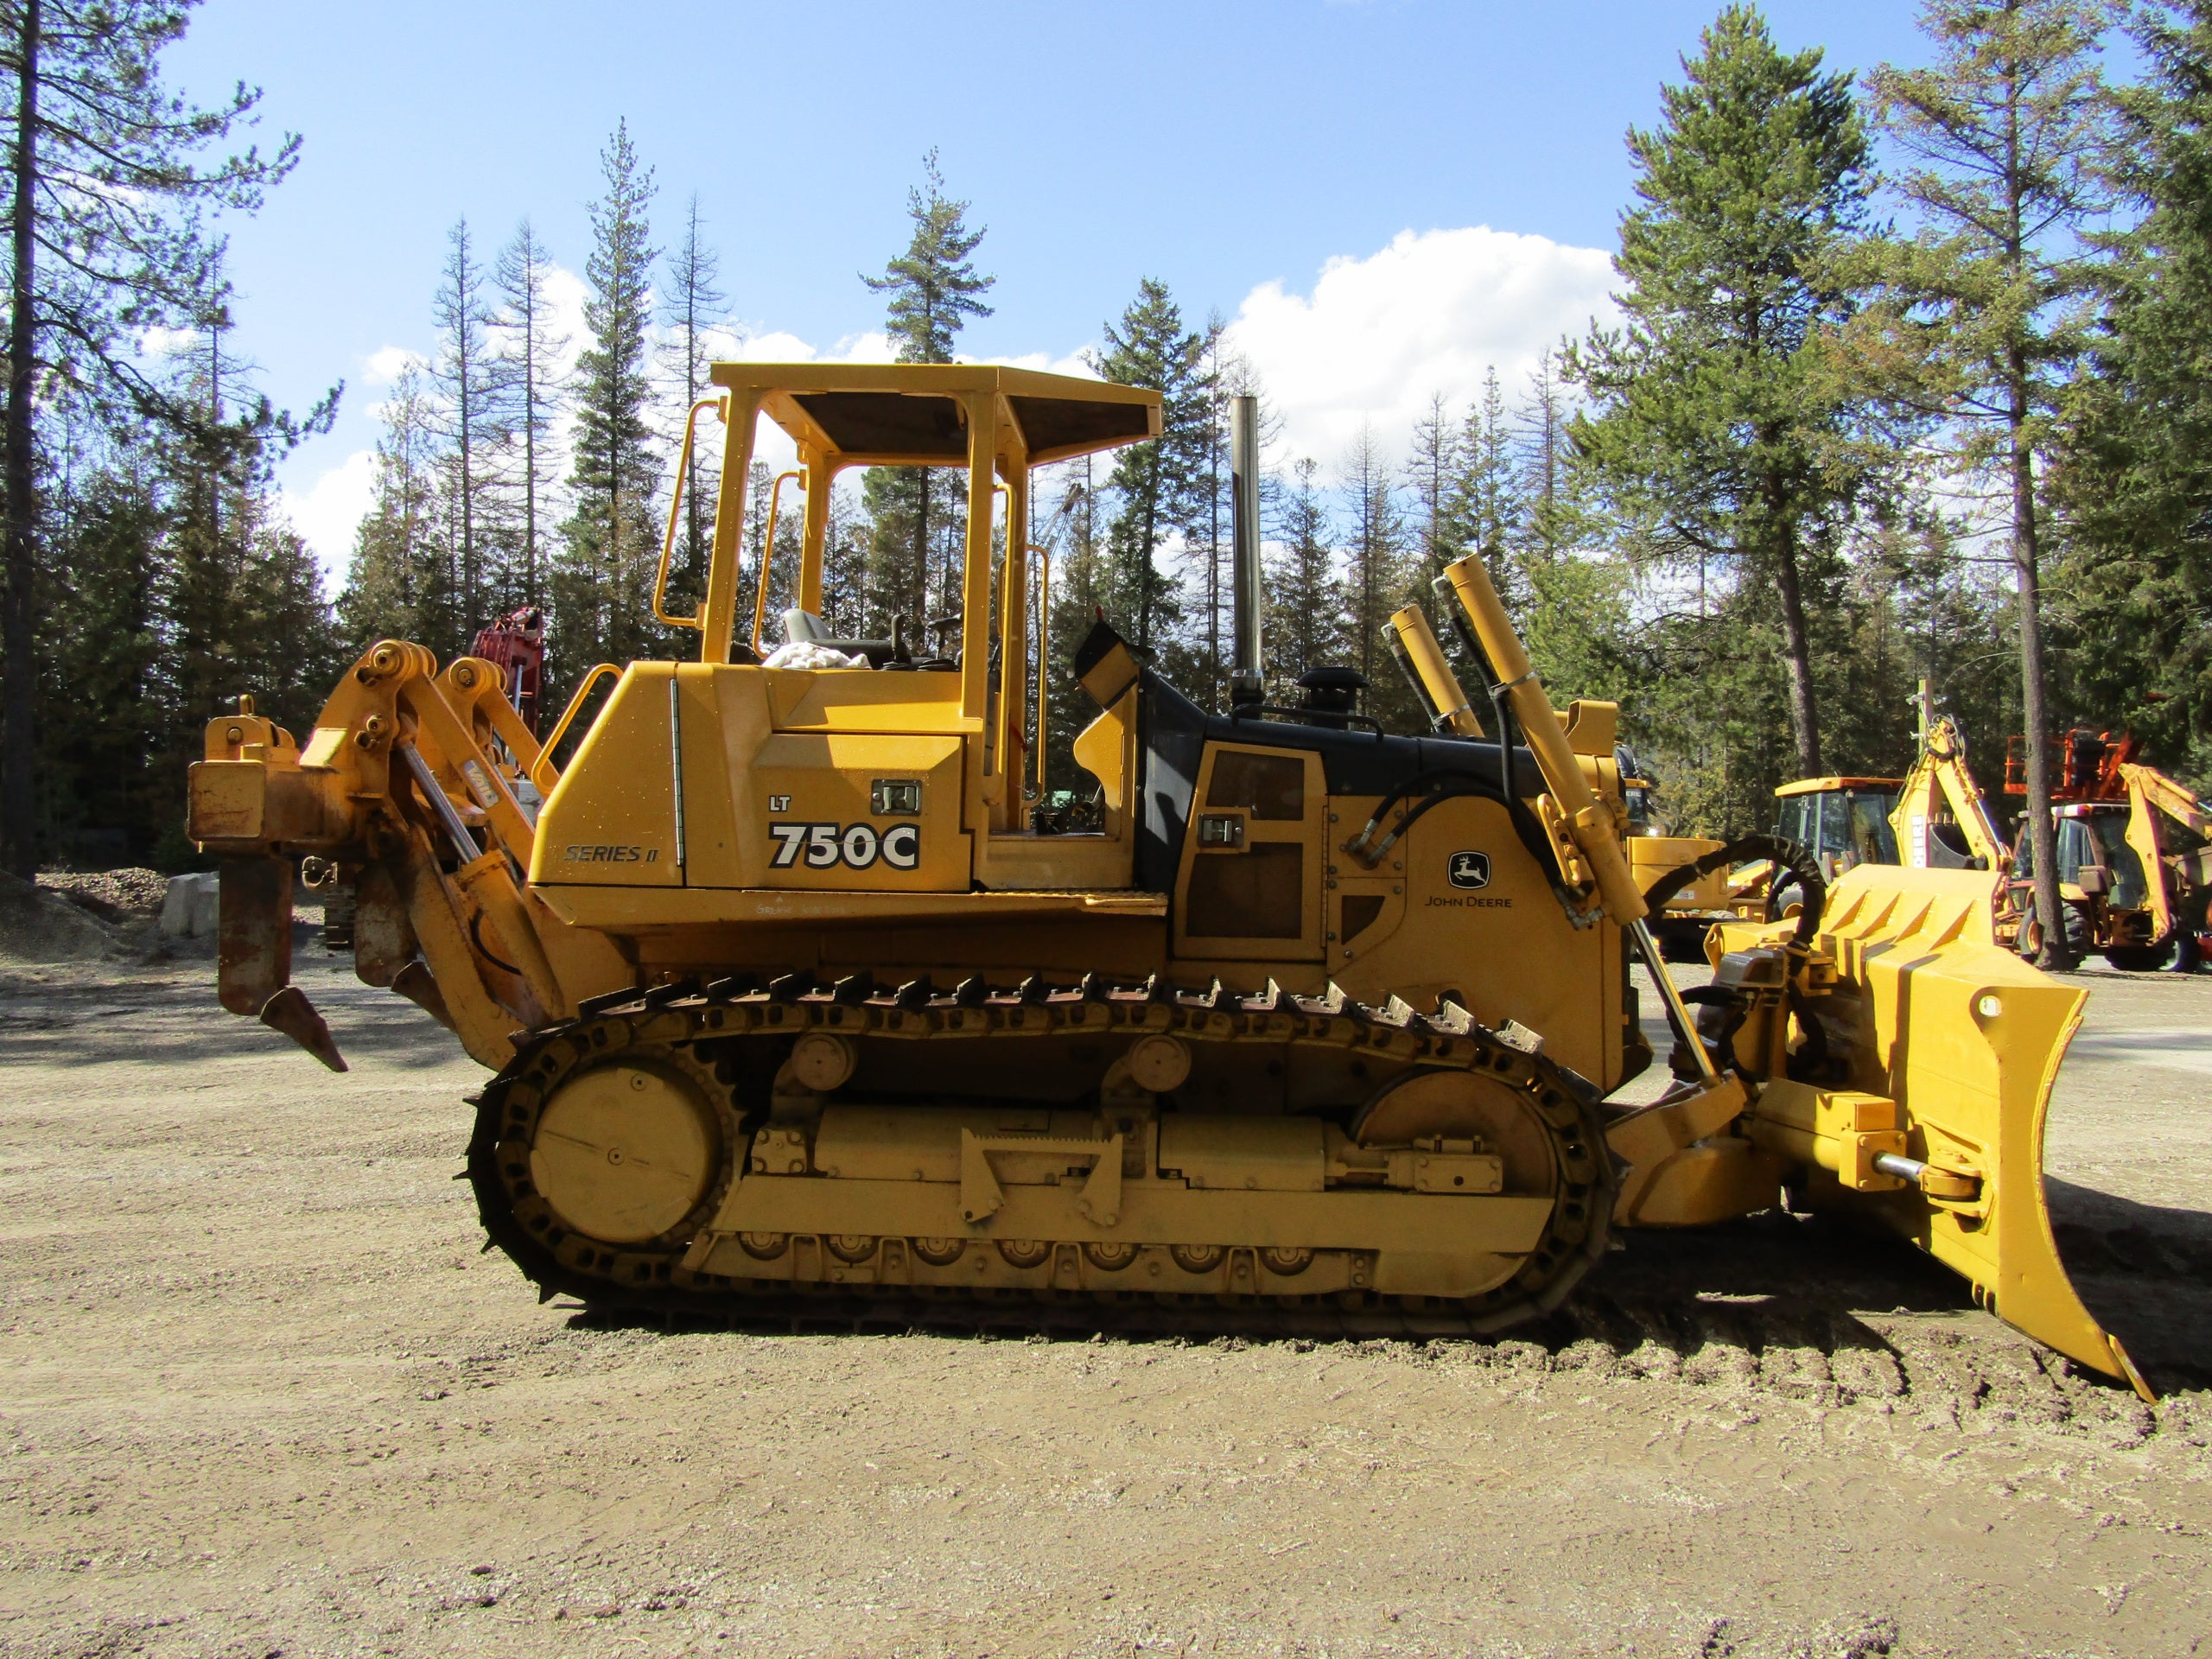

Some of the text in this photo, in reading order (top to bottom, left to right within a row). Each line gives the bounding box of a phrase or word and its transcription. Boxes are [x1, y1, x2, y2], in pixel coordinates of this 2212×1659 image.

[769, 795, 791, 811] LT
[563, 845, 641, 861] SERIES
[770, 823, 918, 869] 750C
[1425, 896, 1512, 907] JOHN DEERE
